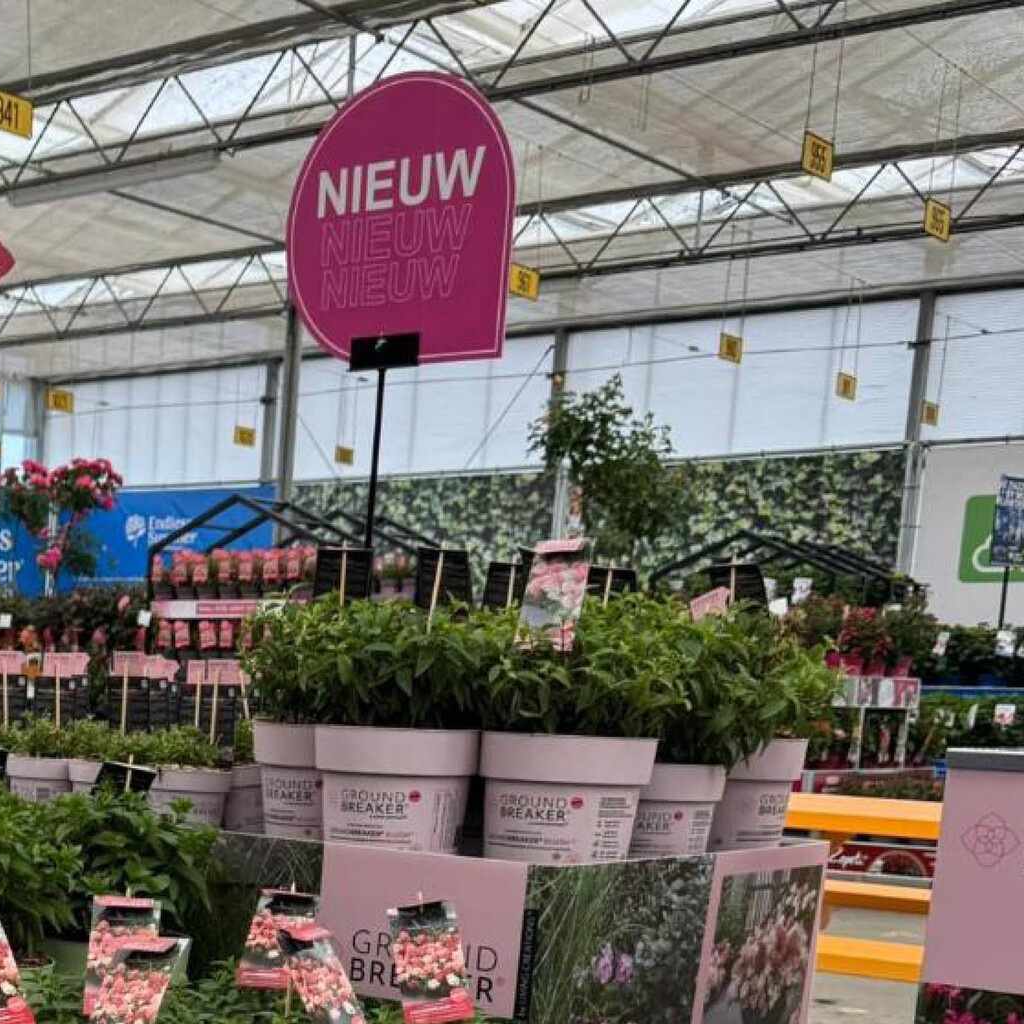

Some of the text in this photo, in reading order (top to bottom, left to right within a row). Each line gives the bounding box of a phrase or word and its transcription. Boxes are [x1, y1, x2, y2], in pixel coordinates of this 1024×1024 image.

[317, 145, 486, 219] NIEUW
[322, 203, 473, 267] NIEUW
[322, 254, 460, 311] NIEUW
[342, 789, 406, 802] GROUND
[500, 794, 568, 809] GROUND
